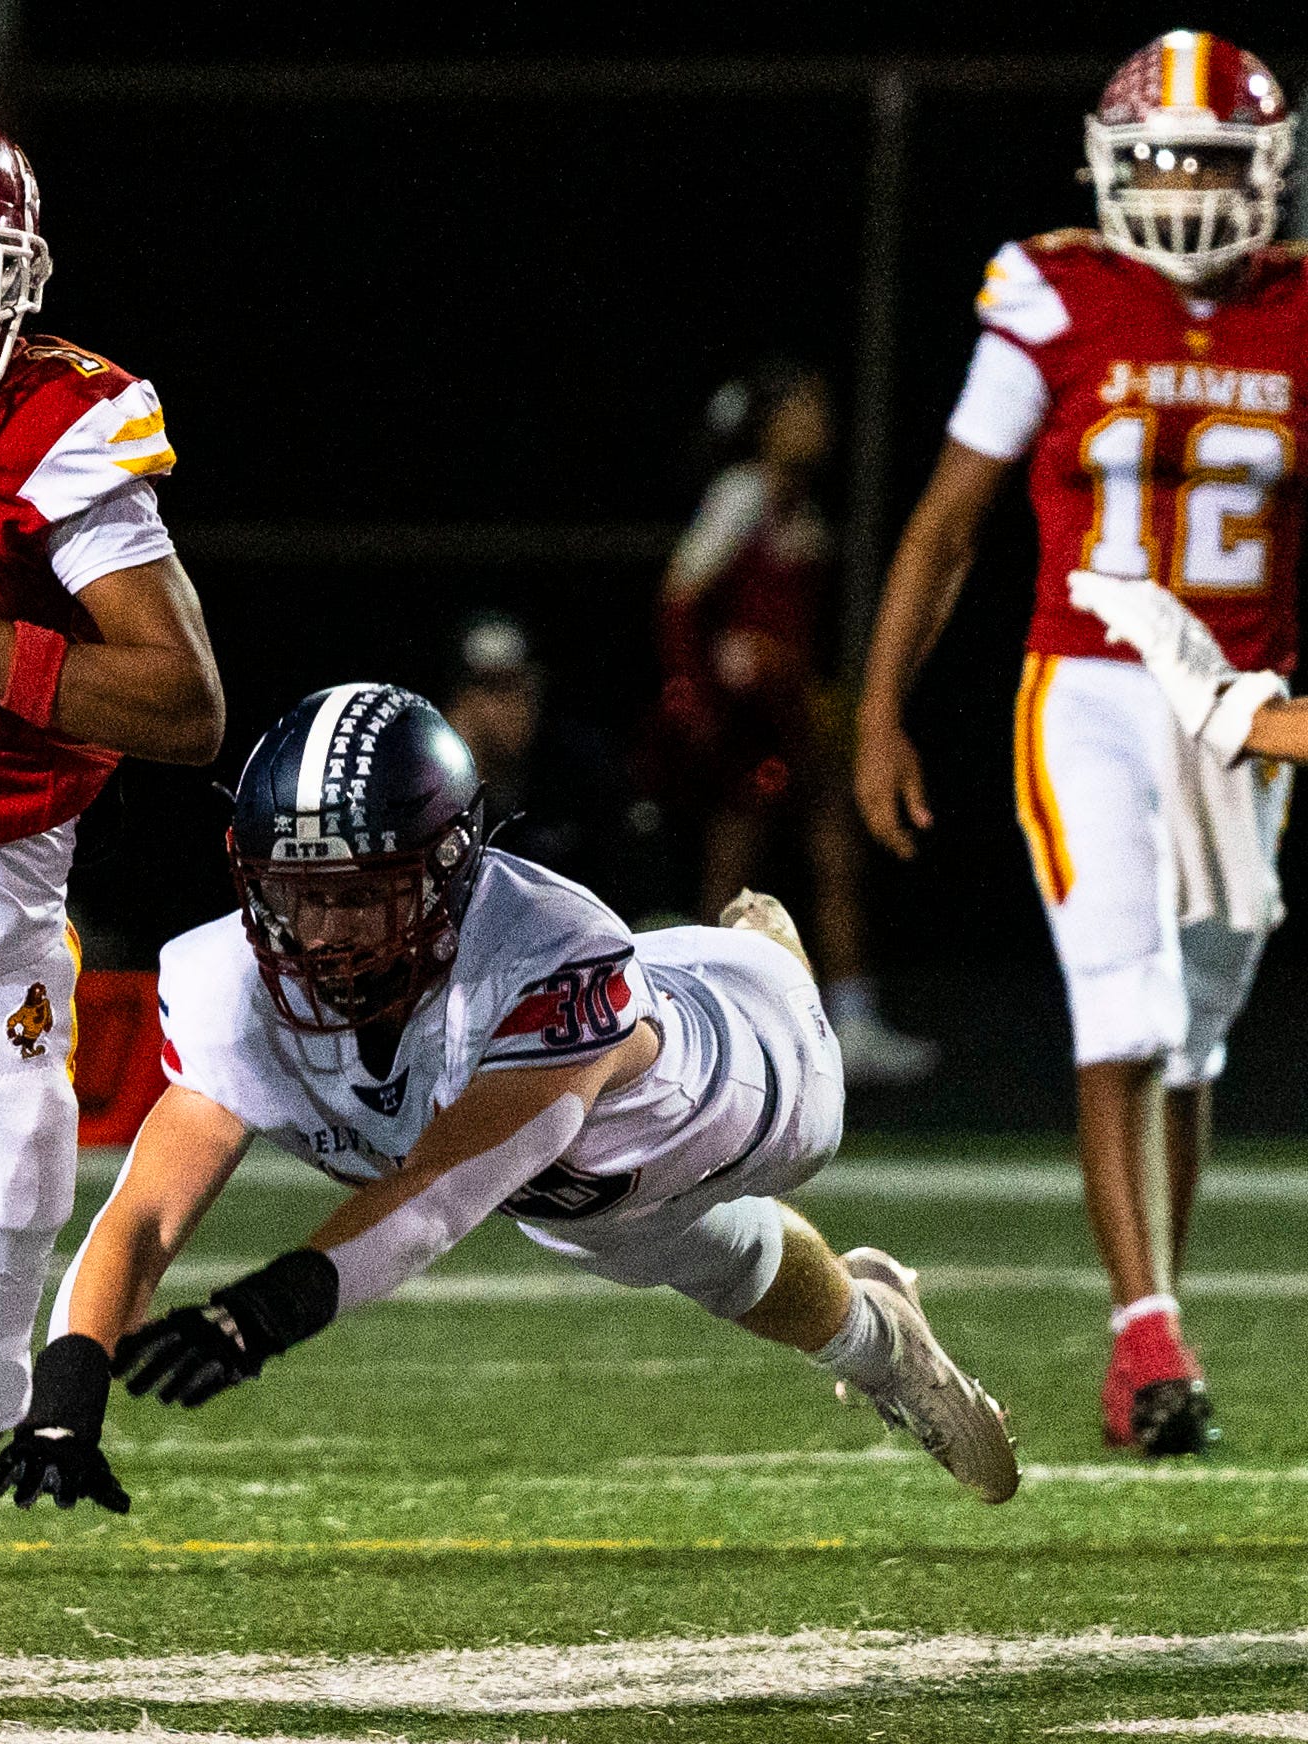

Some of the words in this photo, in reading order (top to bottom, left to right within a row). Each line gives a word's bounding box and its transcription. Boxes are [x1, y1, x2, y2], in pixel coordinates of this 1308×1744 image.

[1101, 361, 1292, 411] J-HAWKS
[1079, 406, 1296, 598] 12
[541, 962, 620, 1049] 30
